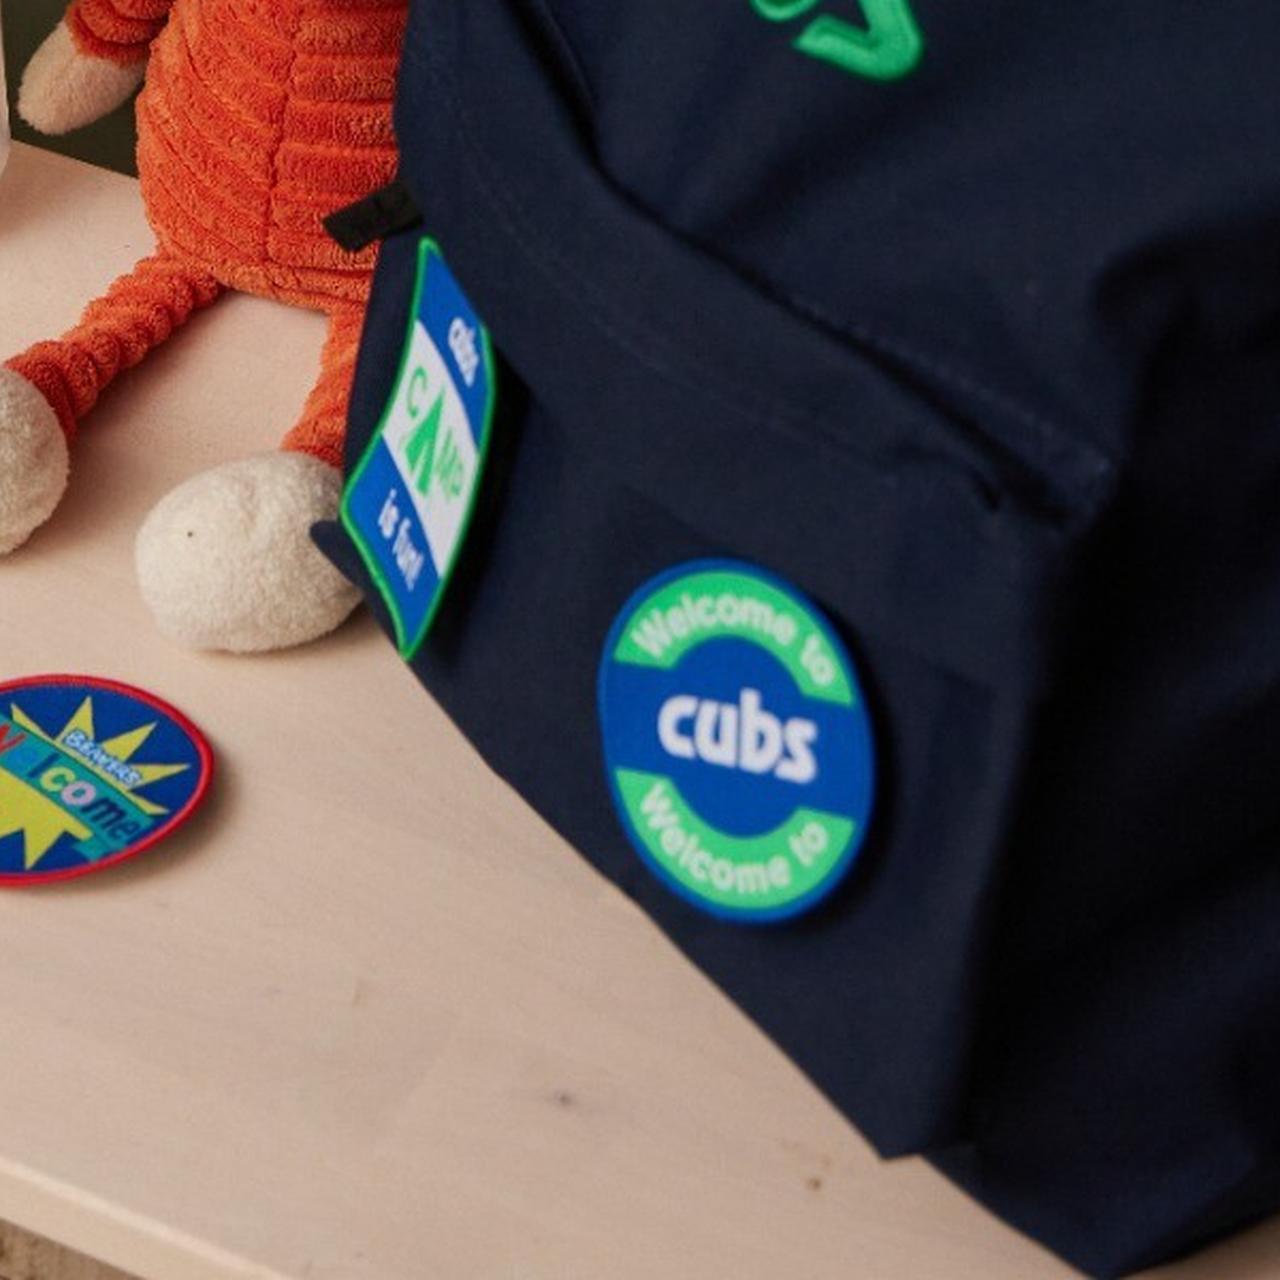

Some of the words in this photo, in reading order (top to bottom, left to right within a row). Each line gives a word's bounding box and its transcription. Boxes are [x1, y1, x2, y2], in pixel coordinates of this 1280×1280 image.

[378, 488, 399, 539] is
[630, 592, 798, 659] Welcome
[800, 633, 836, 687] to
[657, 687, 819, 786] cubs
[640, 779, 792, 895] Welcome
[788, 822, 829, 868] to
